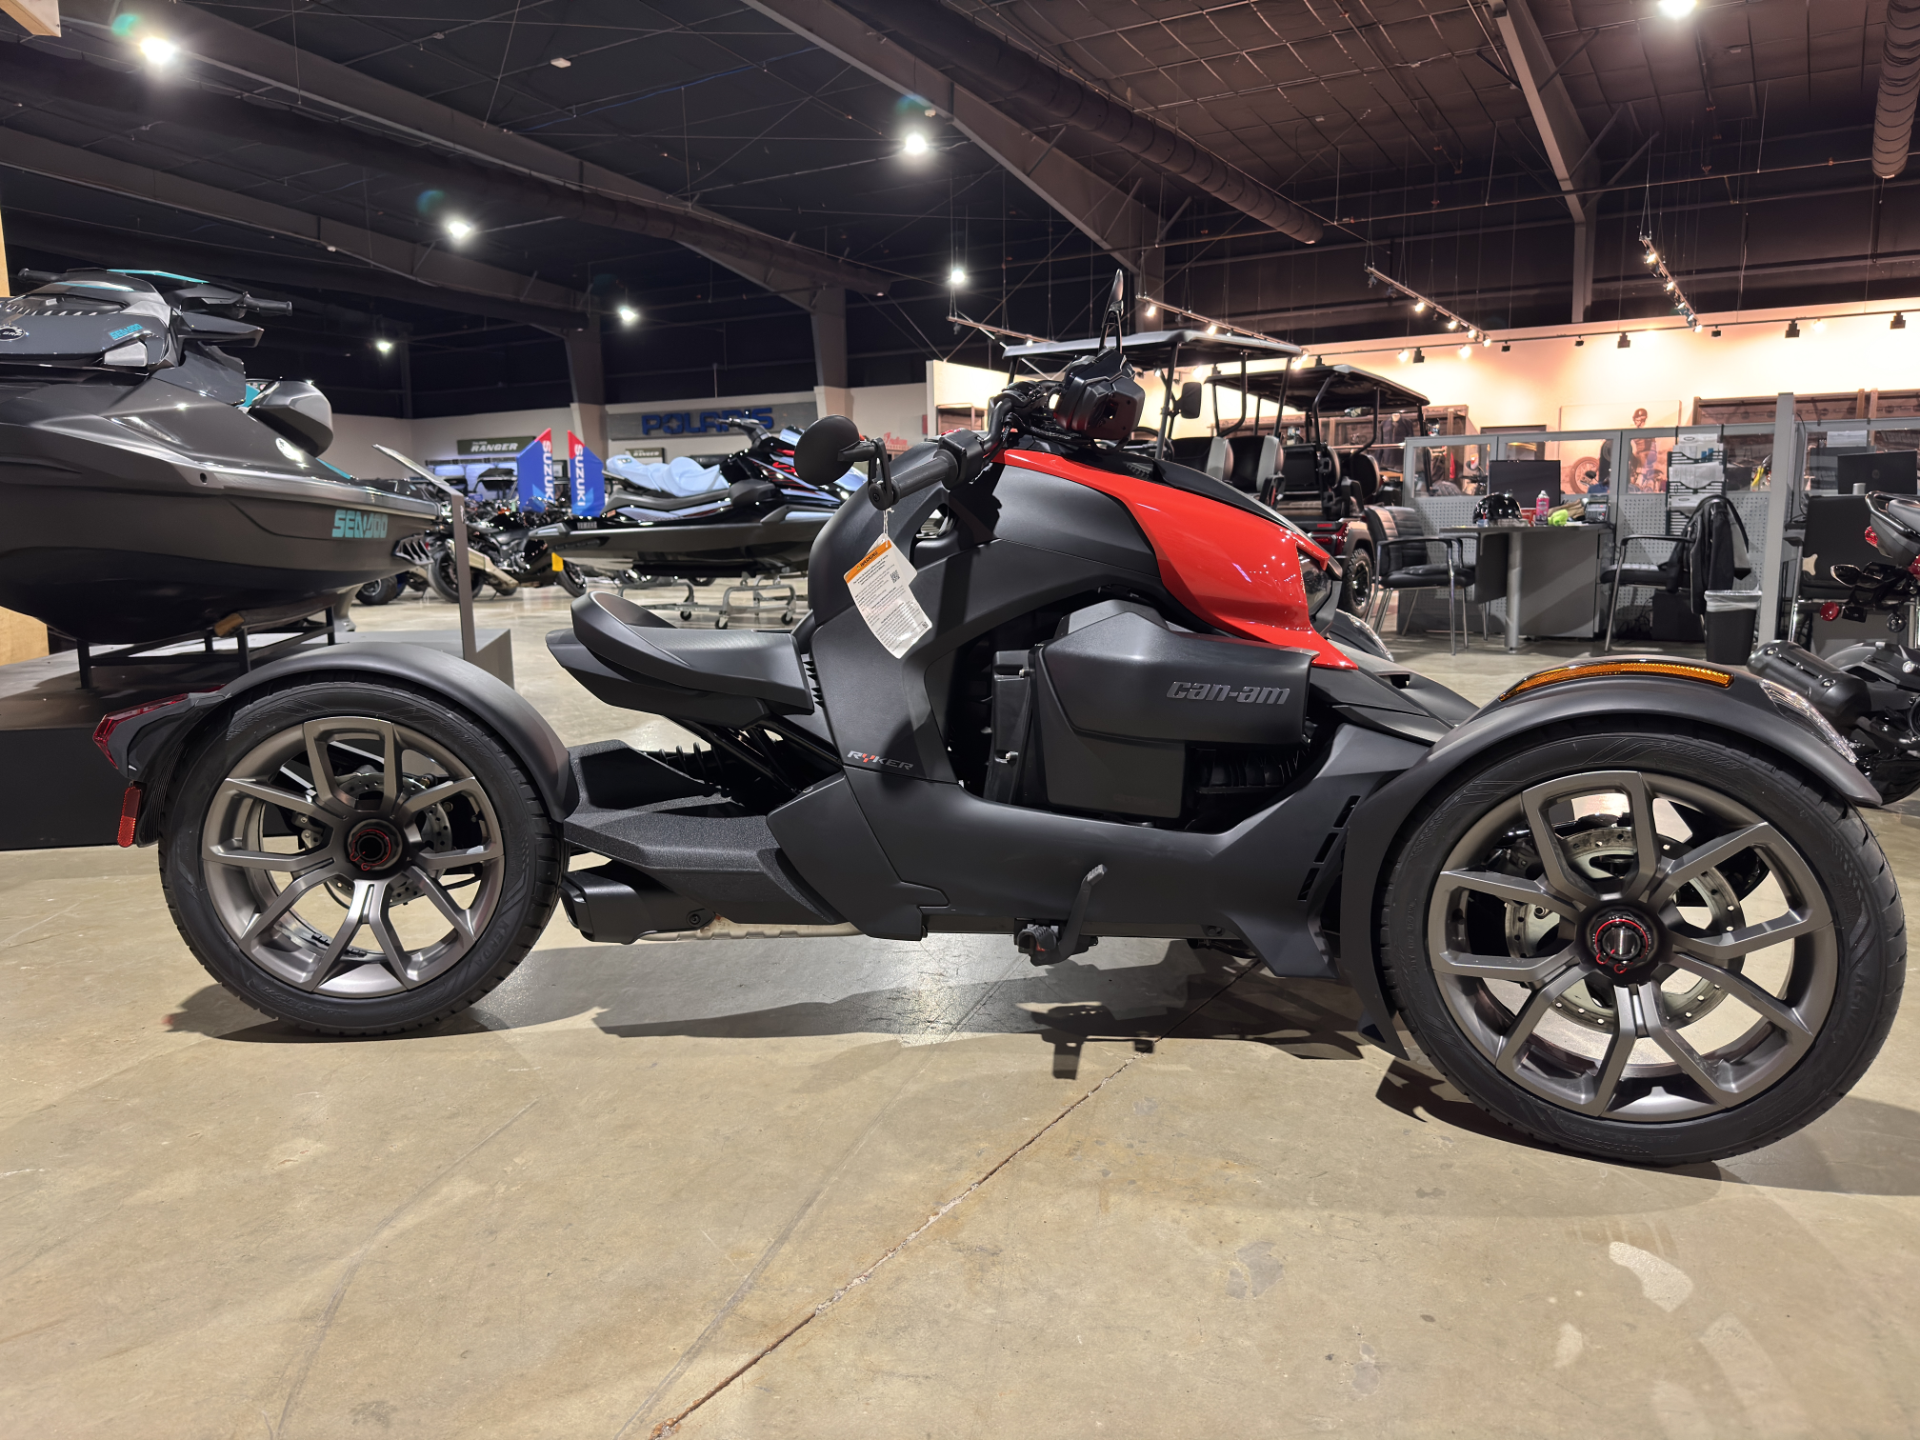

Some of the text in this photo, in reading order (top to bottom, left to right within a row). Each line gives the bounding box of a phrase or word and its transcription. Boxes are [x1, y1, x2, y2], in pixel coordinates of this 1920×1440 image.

[470, 442, 518, 453] RANGER
[574, 443, 586, 506] SUZUKI
[847, 750, 914, 771] RYKER
